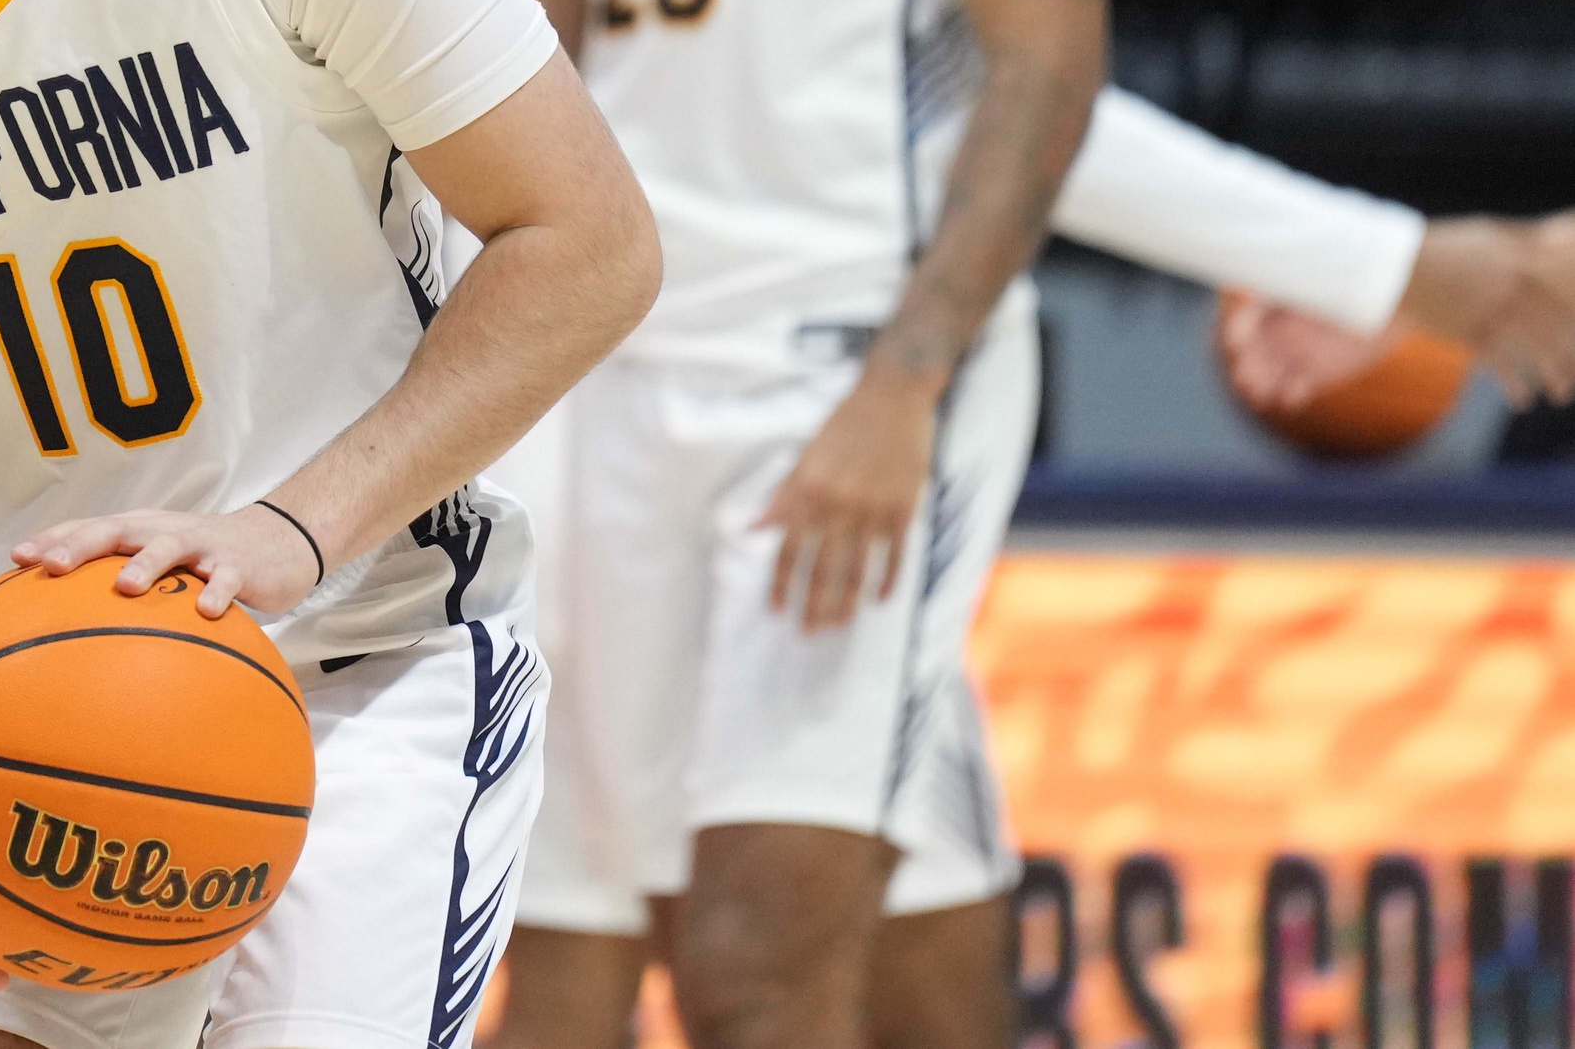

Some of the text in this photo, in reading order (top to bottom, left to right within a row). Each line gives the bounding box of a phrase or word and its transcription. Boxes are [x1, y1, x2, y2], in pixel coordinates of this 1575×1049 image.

[7, 799, 270, 913] Wilson
[77, 901, 130, 919] INDOOR
[134, 912, 171, 924] GAME
